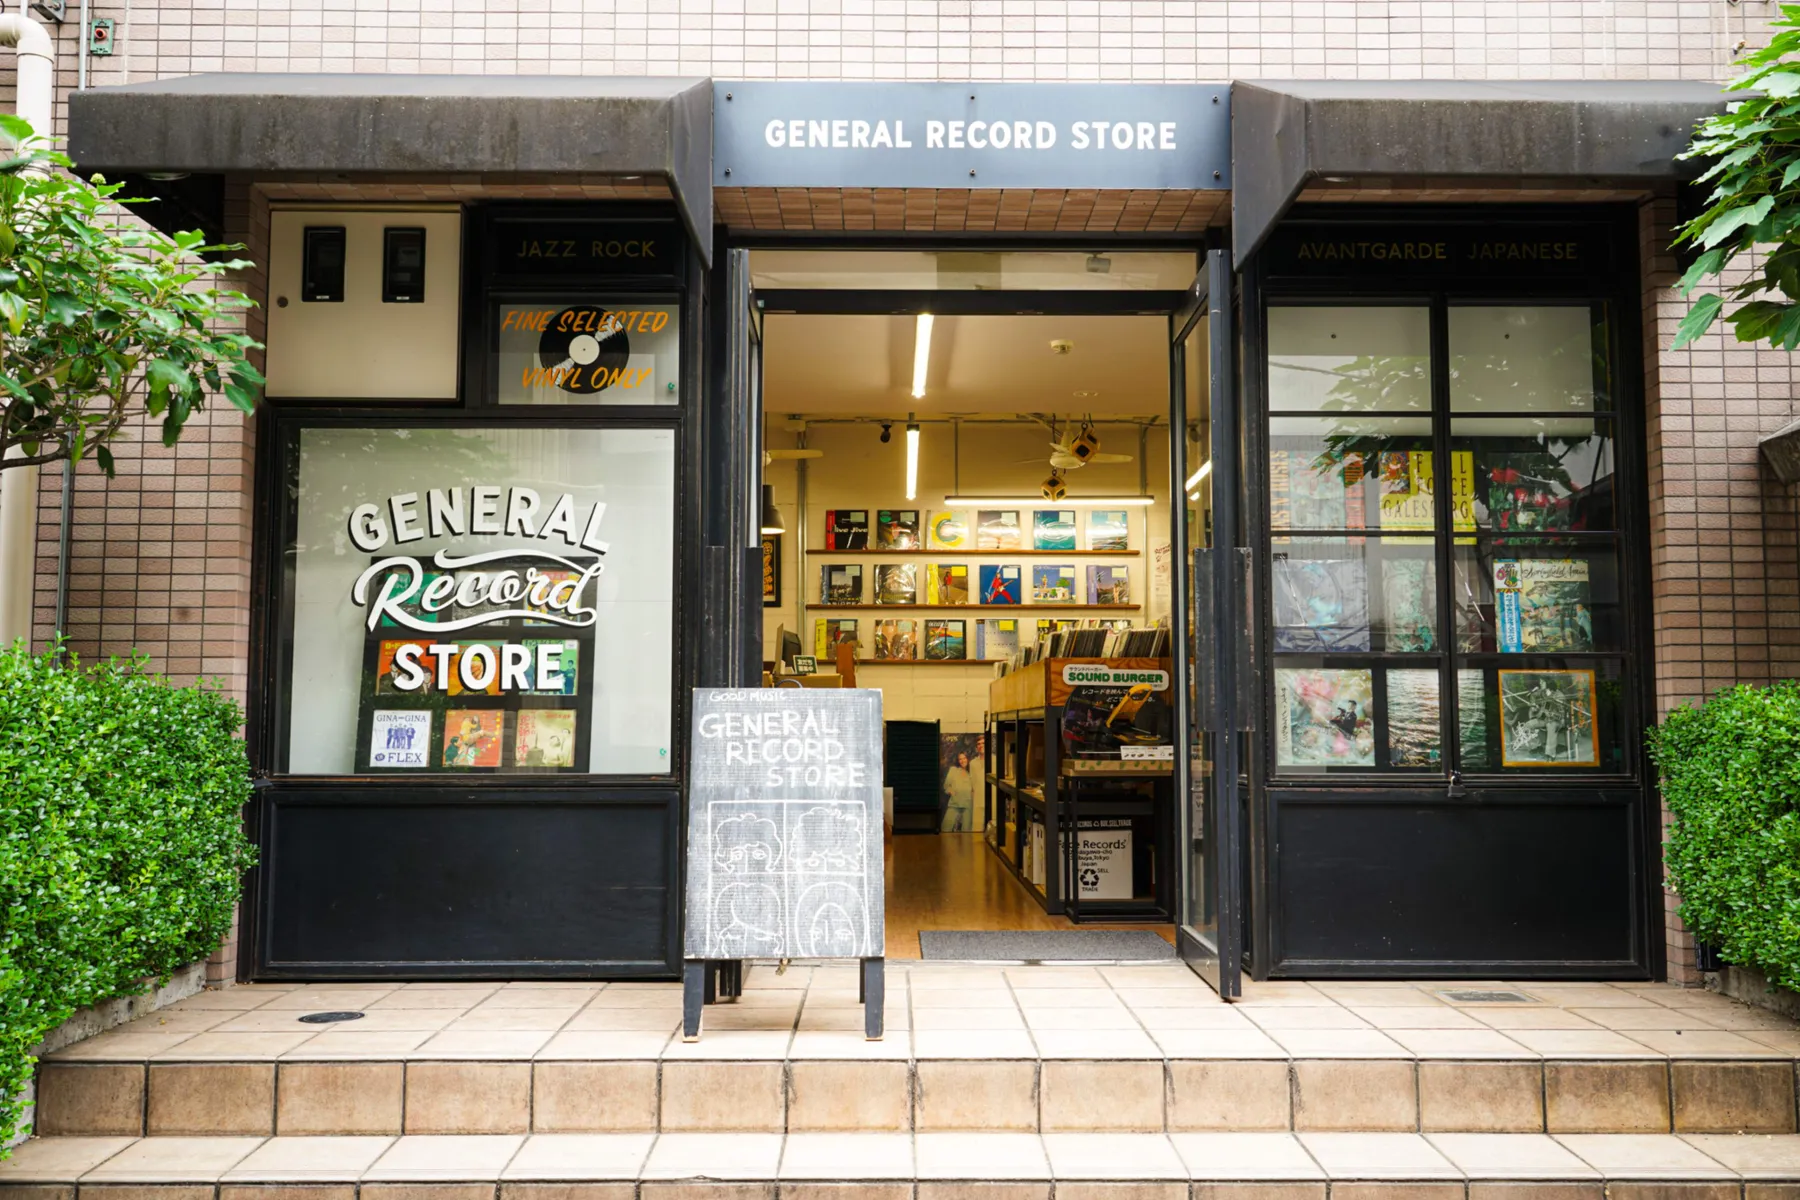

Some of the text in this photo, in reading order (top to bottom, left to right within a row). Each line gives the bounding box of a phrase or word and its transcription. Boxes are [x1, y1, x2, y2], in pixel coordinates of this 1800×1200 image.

[764, 119, 1177, 150] GENERAL RECORD STORE
[517, 240, 656, 258] JAZZ ROCK
[1298, 242, 1578, 260] AVANTGARDE JAPANESE
[501, 310, 669, 333] FINE SELECTED
[521, 366, 653, 389] VINYL ONLY
[1416, 453, 1467, 474] FL
[1416, 477, 1468, 497] FOCE
[347, 485, 612, 556] GENERAL
[351, 548, 605, 632] Record
[392, 643, 564, 693] STORE
[1068, 672, 1164, 683] SOUND BURGER
[750, 690, 787, 702] MUSIC
[698, 710, 840, 739] GENERAL
[387, 752, 423, 763] FLEX
[726, 738, 845, 765] RECORD
[766, 762, 866, 788] STORE
